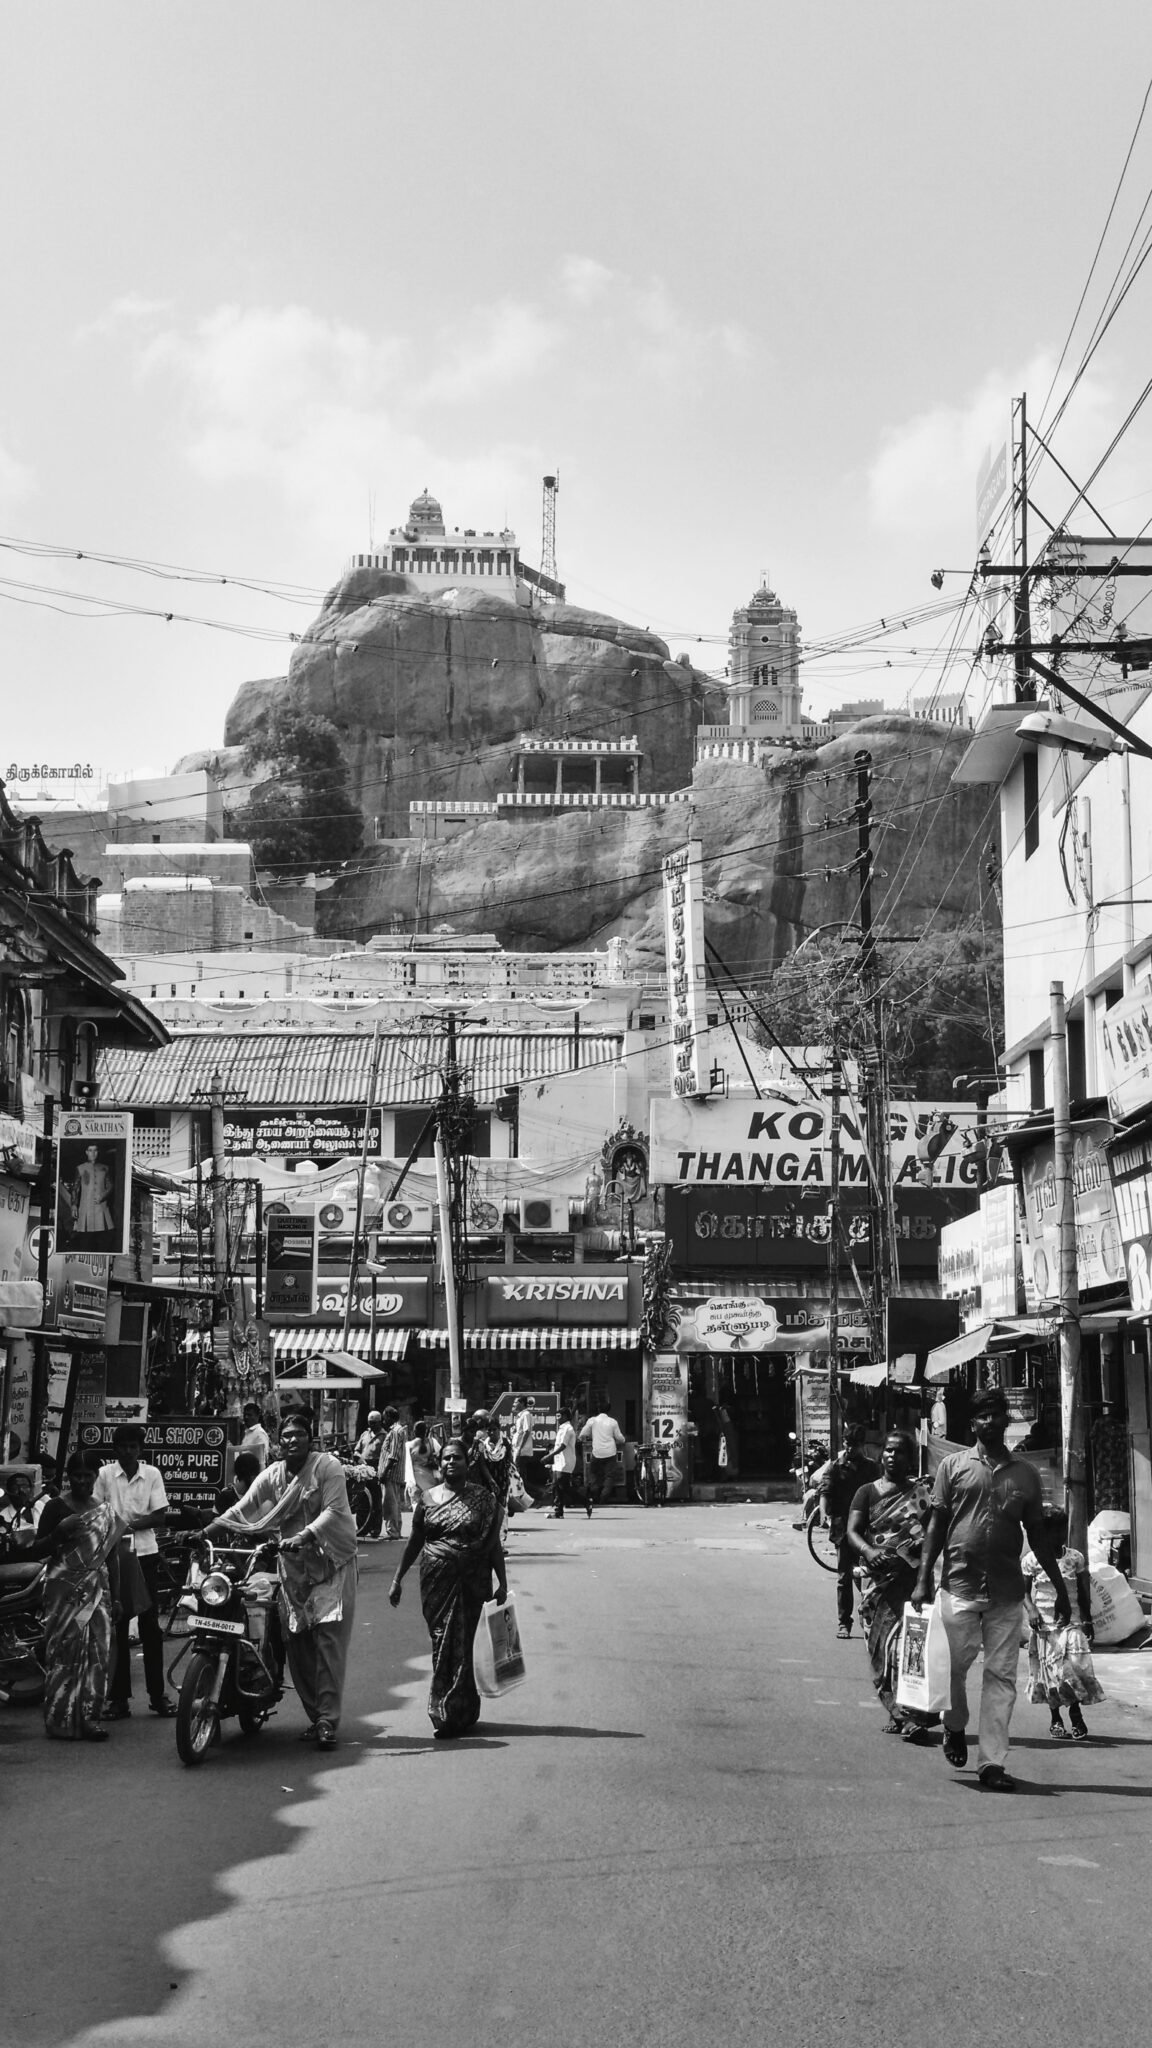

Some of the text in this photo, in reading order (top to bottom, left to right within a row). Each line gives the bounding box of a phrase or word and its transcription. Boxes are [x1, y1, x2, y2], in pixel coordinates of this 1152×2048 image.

[6, 763, 94, 782] திருக்கோயில்
[84, 1122, 125, 1133] SARATHA'S
[502, 1283, 624, 1301] KRISHNA
[166, 1427, 204, 1444] SHOP
[155, 1454, 184, 1466] 100%
[188, 1454, 219, 1466] PURE
